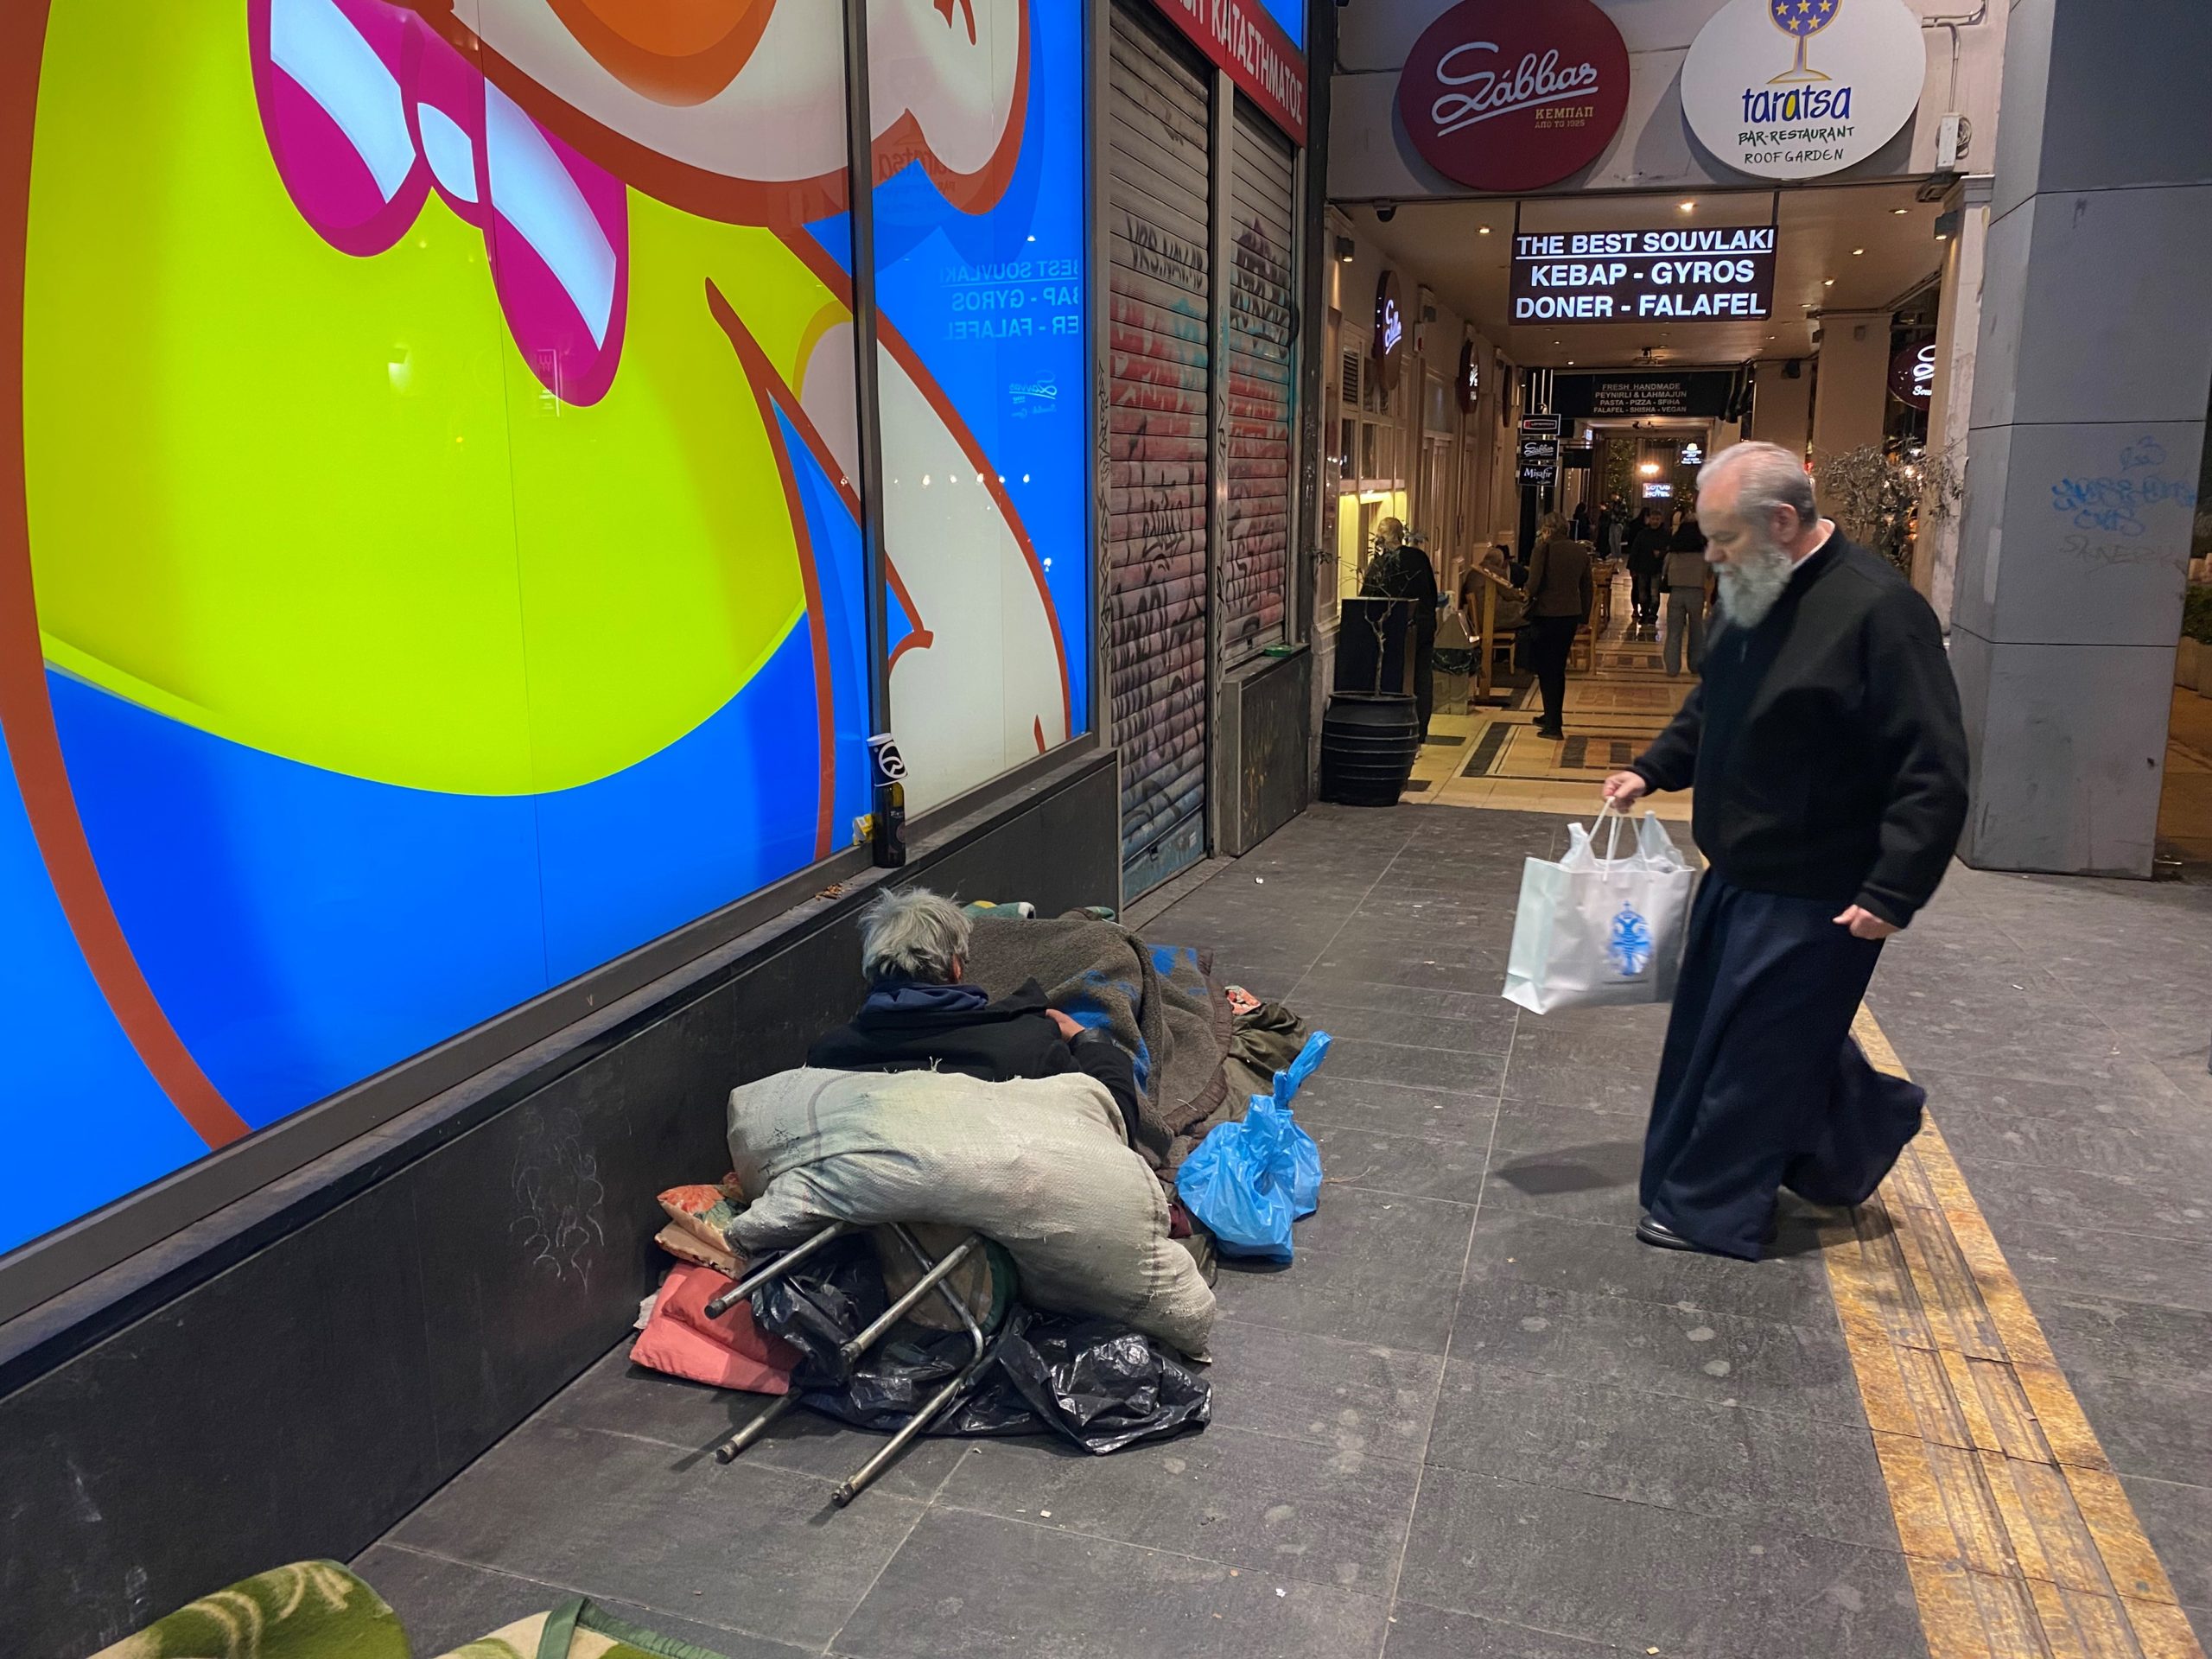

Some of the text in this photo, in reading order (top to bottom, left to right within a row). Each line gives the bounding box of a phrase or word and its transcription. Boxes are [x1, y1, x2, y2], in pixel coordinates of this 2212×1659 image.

[1535, 106, 1594, 120] ΚΕΜΠΑΠ
[1742, 85, 1852, 123] taratsa
[1738, 125, 1855, 147] BAR-RESTAURANT
[1745, 149, 1844, 164] ROOF GARDEN
[1517, 229, 1775, 255] THE BEST SOUVLAKI
[1531, 264, 1627, 287] KEBAP
[1651, 260, 1755, 284] GYROS
[1516, 296, 1613, 318] DONER
[1638, 293, 1766, 317] FALAFEL
